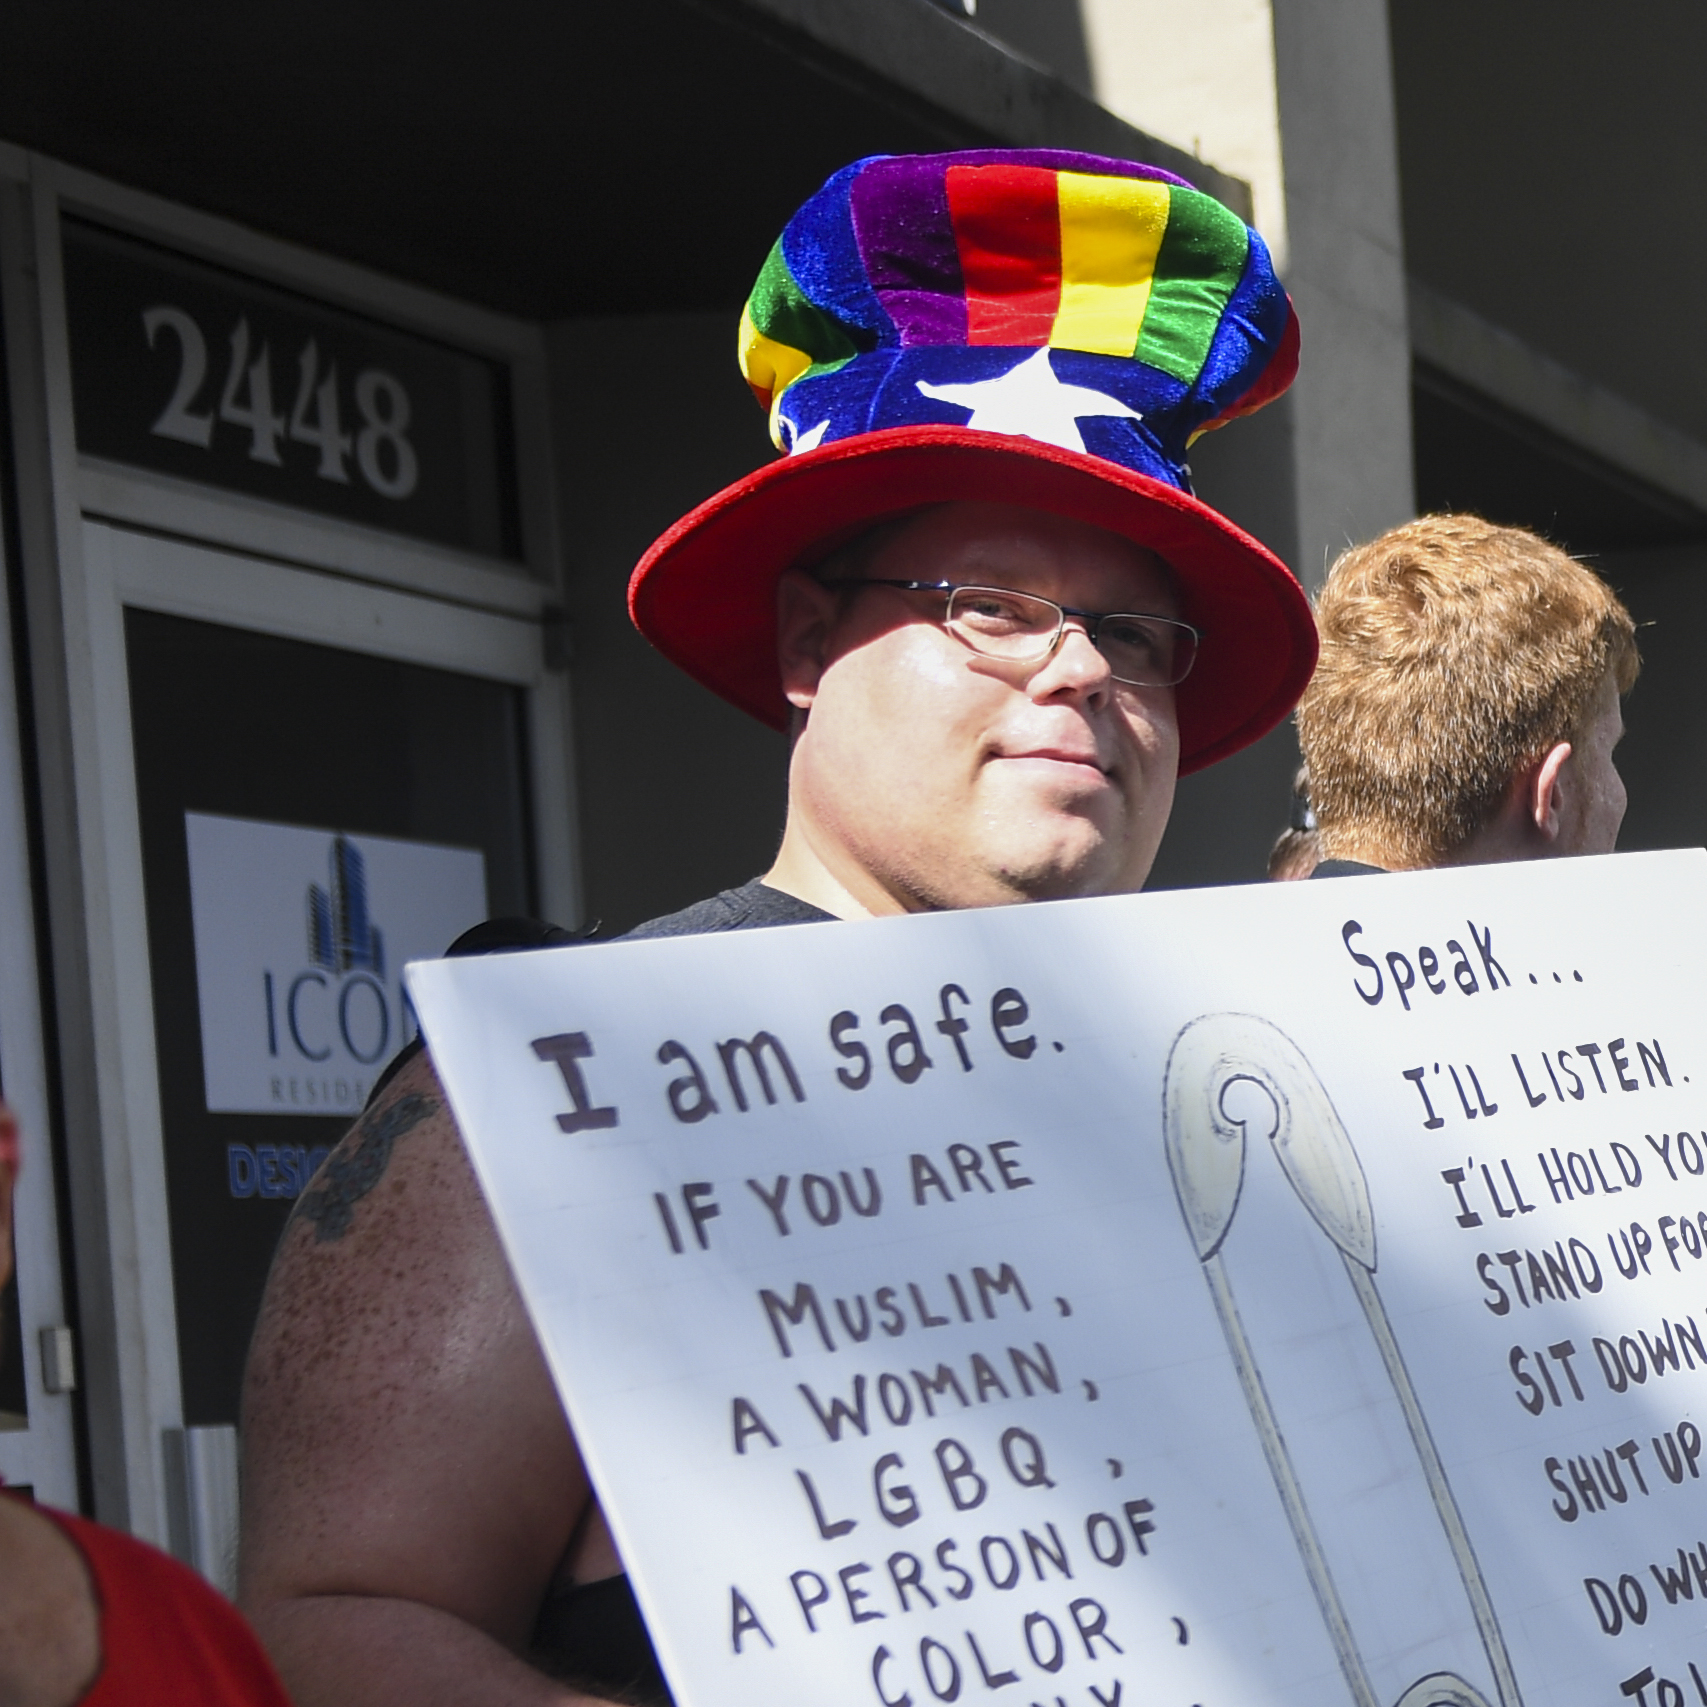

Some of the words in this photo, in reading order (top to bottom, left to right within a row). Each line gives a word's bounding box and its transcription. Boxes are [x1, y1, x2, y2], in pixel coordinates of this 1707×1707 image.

[142, 306, 418, 500] 2448
[1341, 918, 1584, 1011] Speak...
[531, 1031, 618, 1134] I
[656, 1029, 805, 1125] am
[828, 983, 1064, 1090] safe.
[1511, 1037, 1690, 1110] LISTEN.
[654, 1181, 722, 1254] IF
[747, 1165, 881, 1236] YOU
[909, 1139, 1034, 1205] ARE
[1538, 1140, 1644, 1205] HOLD
[1476, 1246, 1602, 1316] STAND
[1606, 1225, 1654, 1282] UP
[732, 1396, 779, 1454] A
[796, 1341, 1101, 1442] WOMAN,
[1509, 1340, 1583, 1417] SIT
[1591, 1315, 1707, 1396] DOWN
[1543, 1441, 1649, 1524] SHUT
[1651, 1422, 1703, 1485] UP
[729, 1584, 775, 1655] A
[788, 1519, 1076, 1634] PERSON
[1084, 1497, 1157, 1568] OF
[1584, 1570, 1649, 1637] DO
